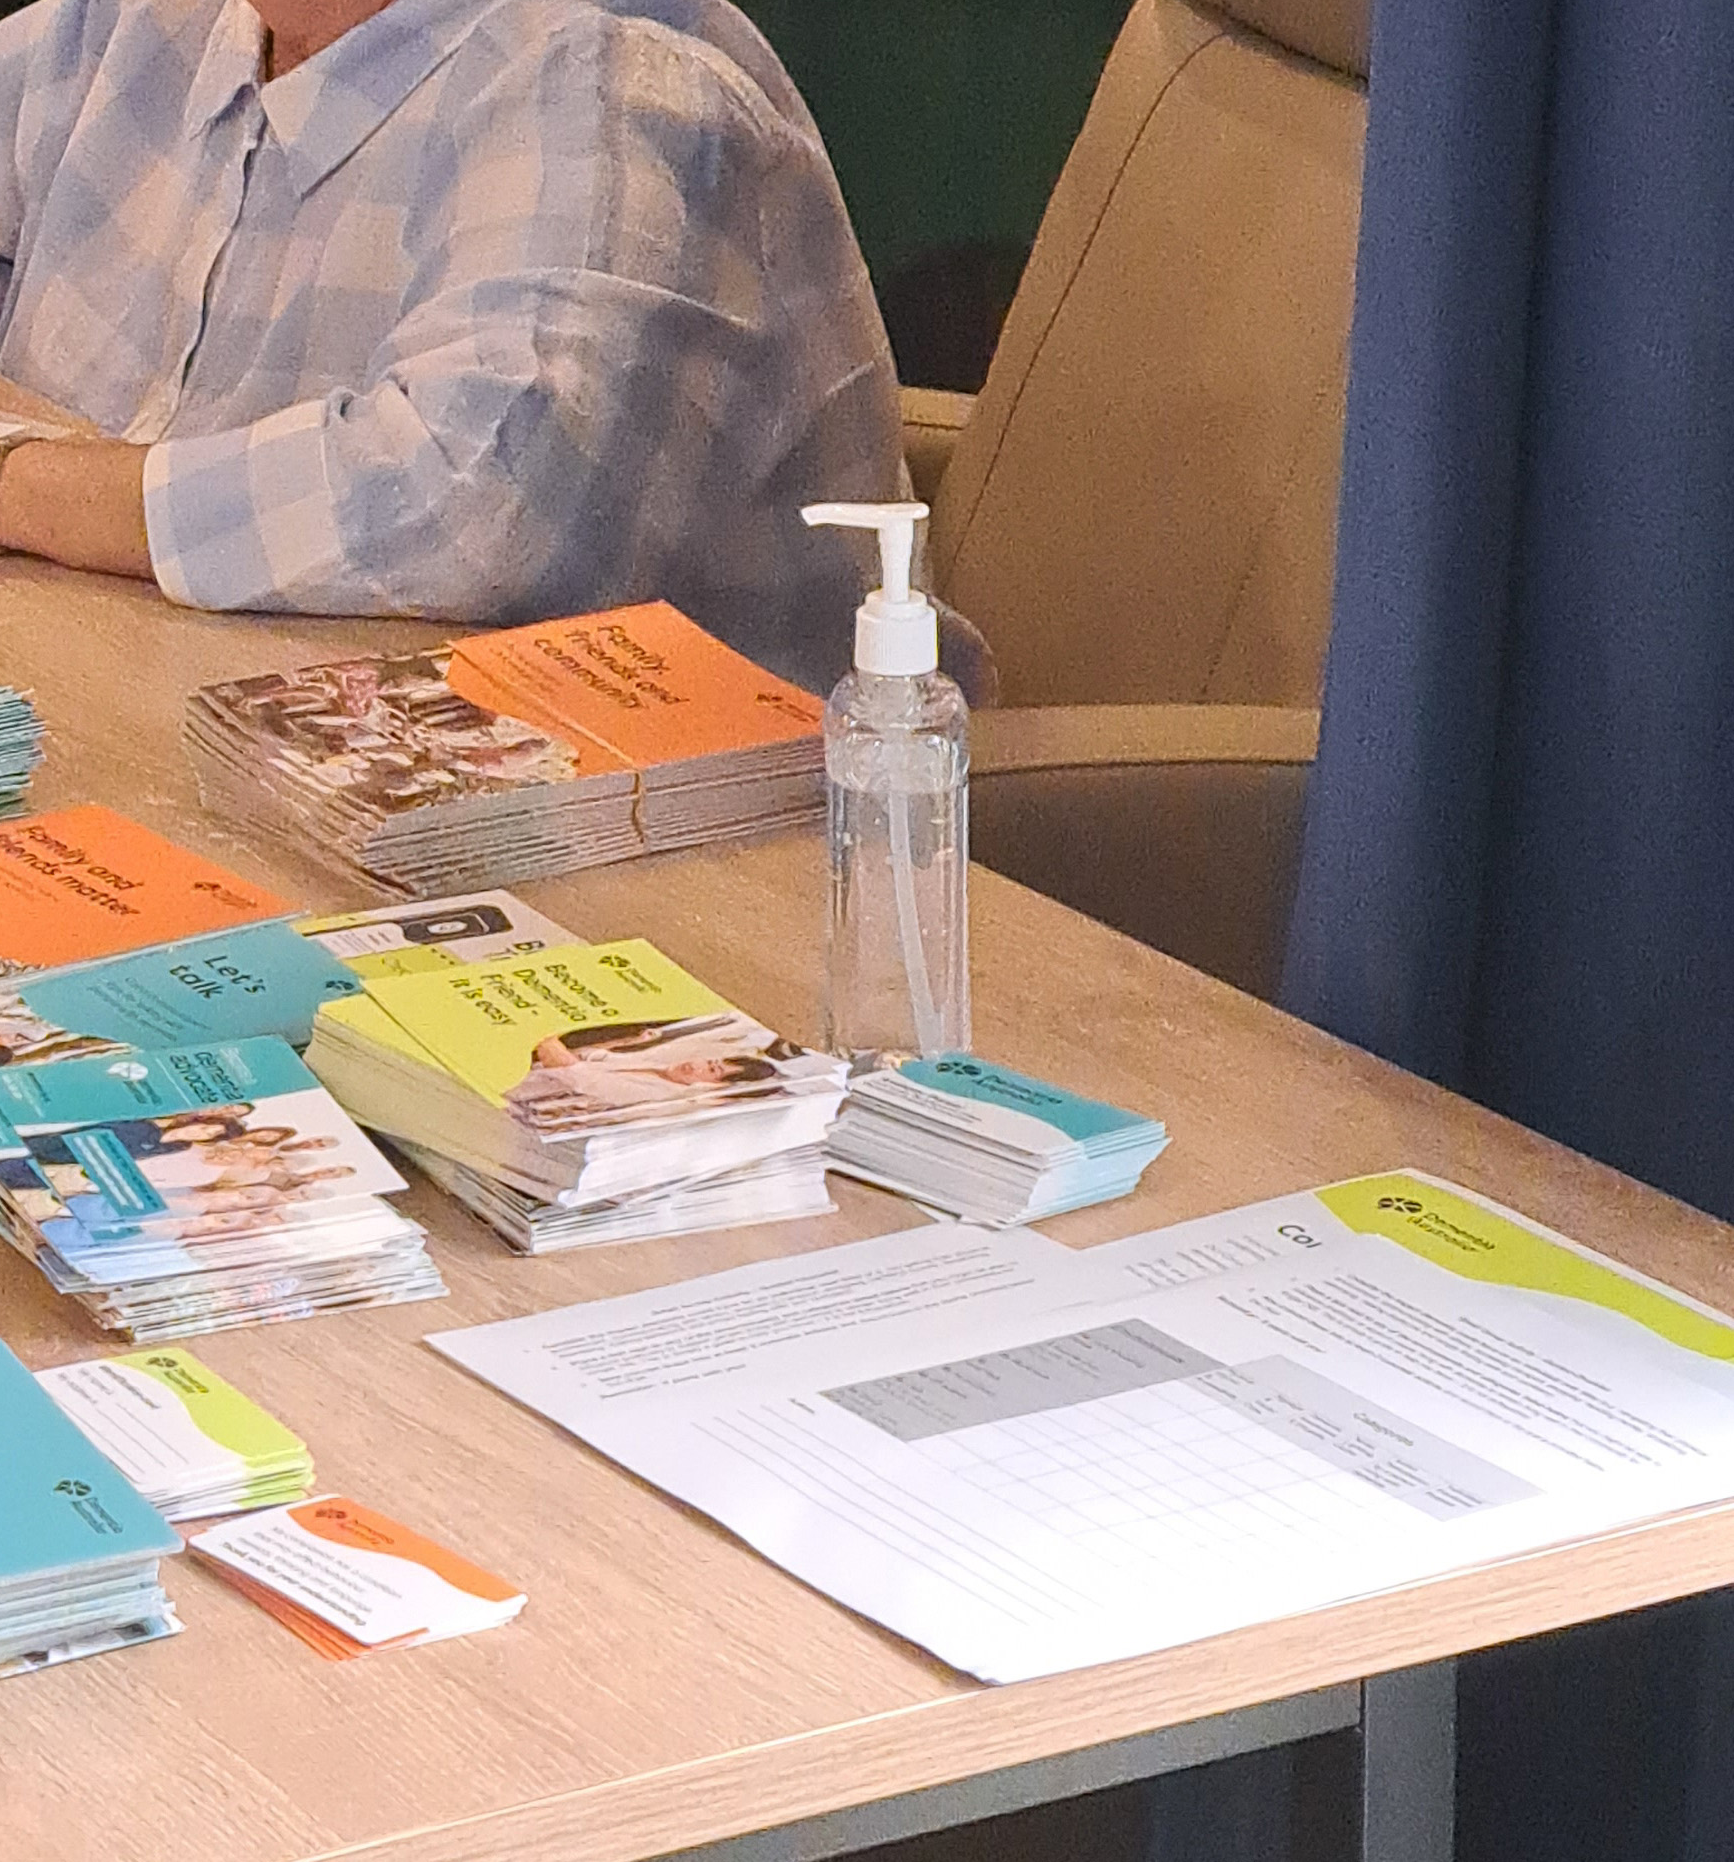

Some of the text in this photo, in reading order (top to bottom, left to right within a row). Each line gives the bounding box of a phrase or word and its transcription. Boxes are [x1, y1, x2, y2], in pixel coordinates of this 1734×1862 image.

[18, 824, 92, 867] Family
[86, 865, 145, 891] and
[56, 874, 142, 916] matter
[168, 964, 224, 1001] talk
[203, 954, 267, 995] Let's
